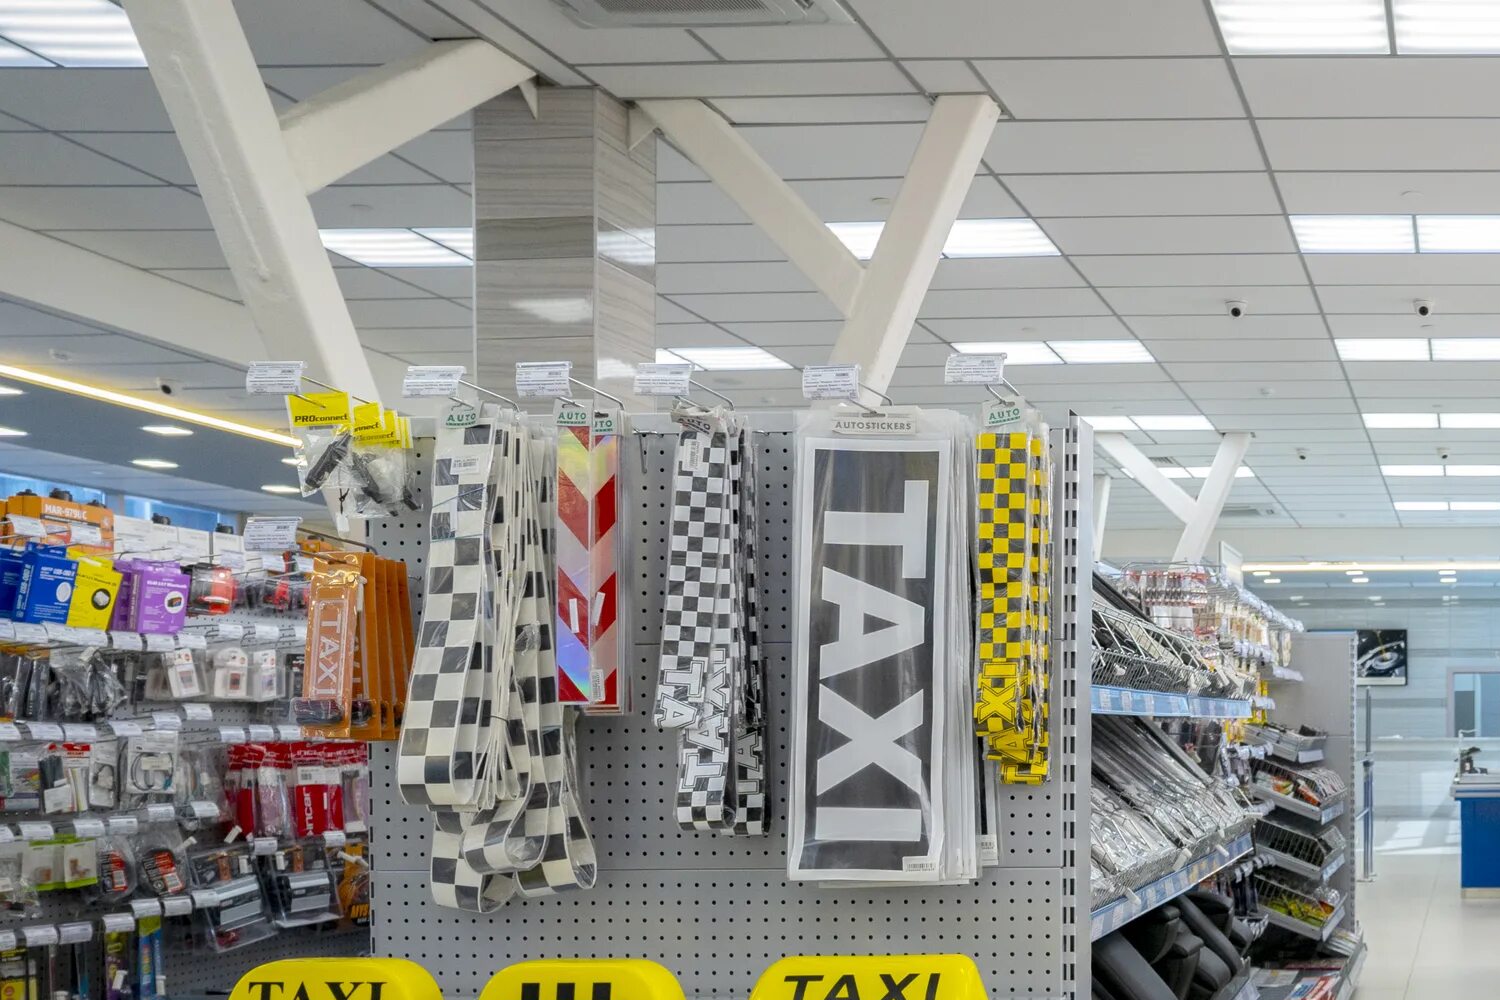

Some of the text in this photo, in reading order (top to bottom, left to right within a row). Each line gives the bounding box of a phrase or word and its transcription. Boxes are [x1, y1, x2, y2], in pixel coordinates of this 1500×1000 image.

[294, 413, 348, 423] PROconnect
[447, 413, 477, 422] AUTO
[558, 412, 586, 420] AUTO
[989, 408, 1020, 420] AUTO
[835, 421, 912, 430] AUTOSTICKERS
[314, 613, 342, 695] TAXI
[815, 480, 929, 841] TAXI
